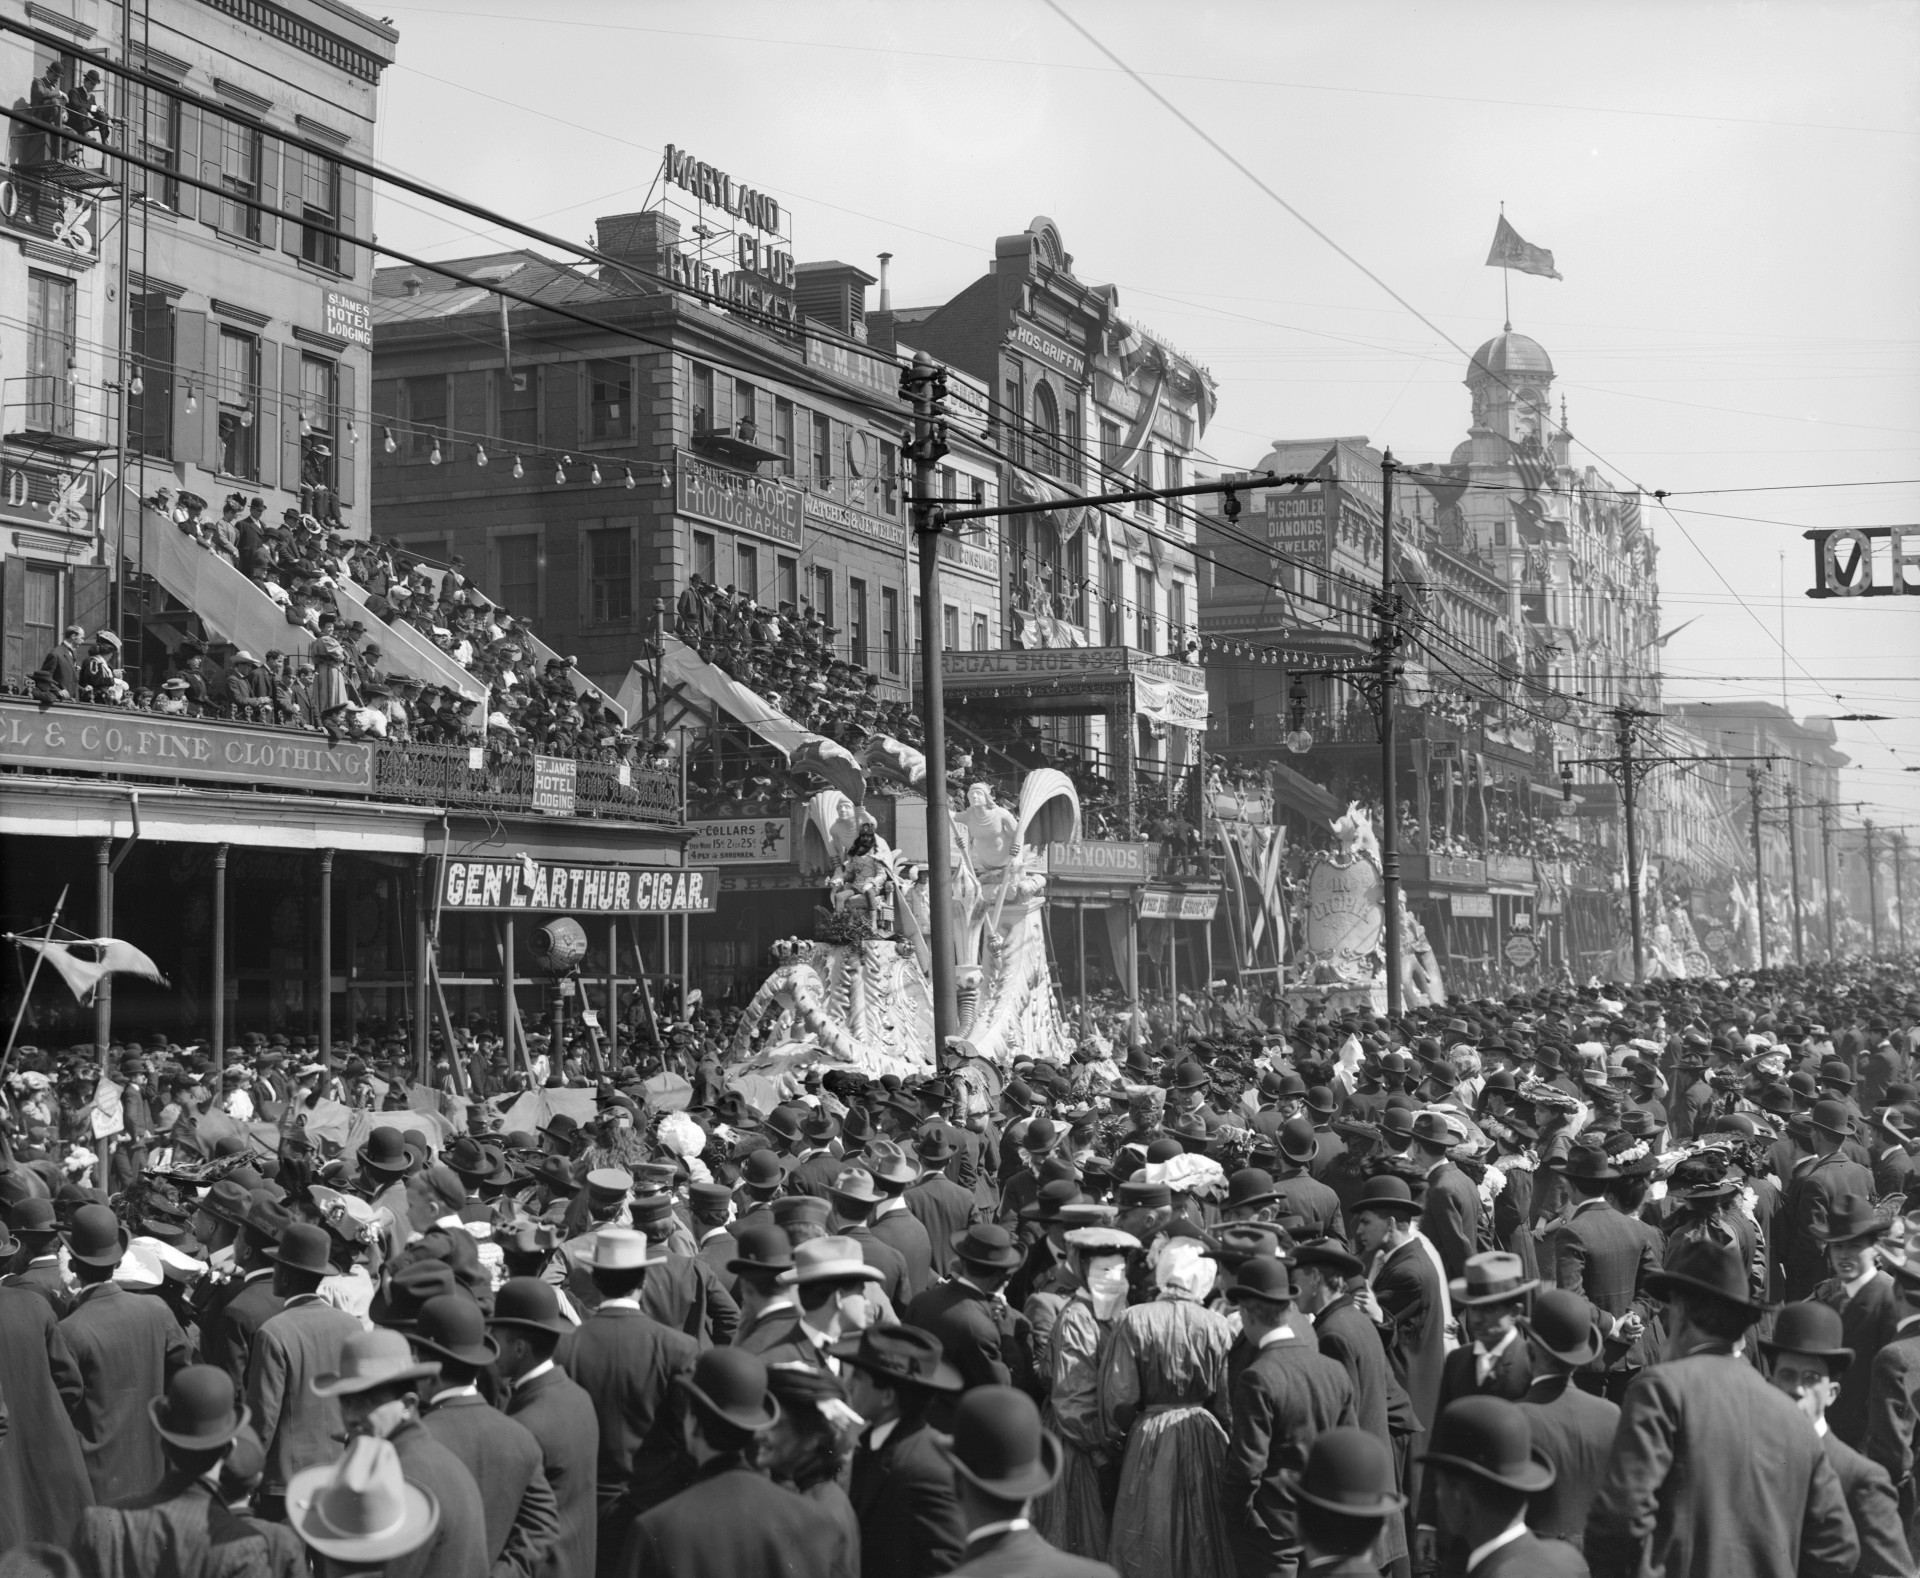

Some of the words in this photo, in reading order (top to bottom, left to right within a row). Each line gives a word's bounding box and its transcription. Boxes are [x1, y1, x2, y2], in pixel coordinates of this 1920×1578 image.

[667, 144, 779, 235] MARYLAND
[739, 233, 796, 290] CLUB
[327, 304, 372, 331] HOTEL
[328, 317, 371, 345] LODGING
[1042, 340, 1084, 375] GRIFFIN
[685, 474, 796, 543] PHOTOGRAPHER.
[747, 479, 796, 528] MOORE
[804, 500, 850, 526] WATCHES
[851, 513, 859, 529] &
[859, 515, 905, 546] JEWELRY
[1015, 653, 1073, 671] SHOE
[44, 722, 66, 747] &
[137, 731, 211, 762] FINE
[224, 741, 362, 775] CLOTHING
[535, 776, 574, 793] HOTEL
[549, 762, 577, 777] JAMES
[533, 791, 574, 809] LODGING
[705, 825, 755, 836] COLLARS
[1054, 845, 1141, 869] DIAMONDS.
[447, 862, 526, 907] GEN'L
[530, 866, 631, 910] ARTHUR
[636, 872, 709, 910] CIGAR.
